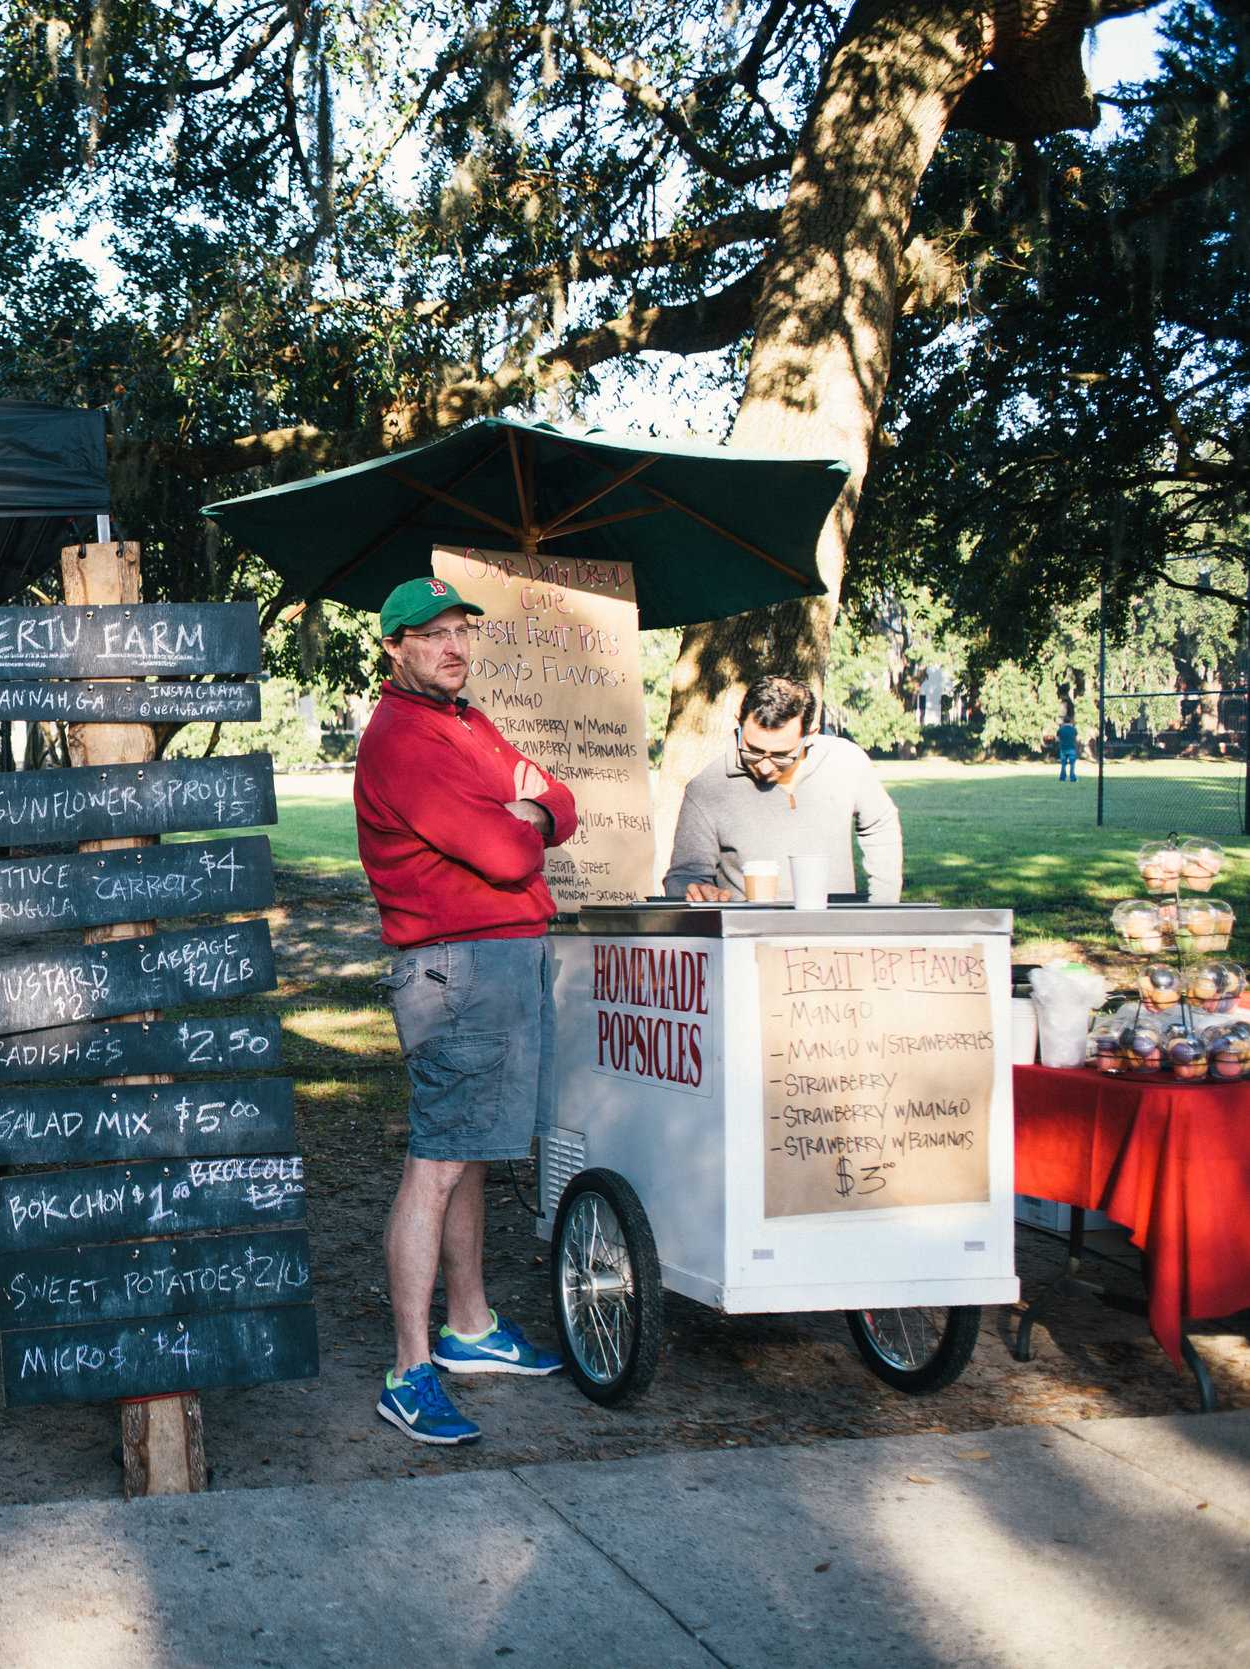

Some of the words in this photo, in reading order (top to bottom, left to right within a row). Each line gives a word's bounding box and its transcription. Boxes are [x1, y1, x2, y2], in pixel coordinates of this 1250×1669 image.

[425, 579, 448, 596] B
[103, 621, 205, 652] FARM
[476, 618, 518, 645] RESH
[76, 692, 104, 710] GA
[149, 685, 243, 699] INSTAGRAM
[150, 775, 256, 808] SPROUTS
[214, 800, 251, 822] $5
[93, 873, 204, 901] CARROTS
[200, 847, 245, 892] $4
[140, 934, 240, 973] CABBAGE
[183, 958, 254, 992] $2/LB
[593, 944, 709, 1014] HOMEMADE
[178, 1022, 269, 1063] $2.50
[598, 1010, 702, 1088] POPSICLES
[95, 1111, 152, 1139] MIX
[9, 1191, 68, 1231] BOK
[11, 1272, 106, 1309] SWEET
[124, 1265, 246, 1299] POTATOES
[20, 1344, 127, 1379] MICROS
[152, 1331, 200, 1372] $4
